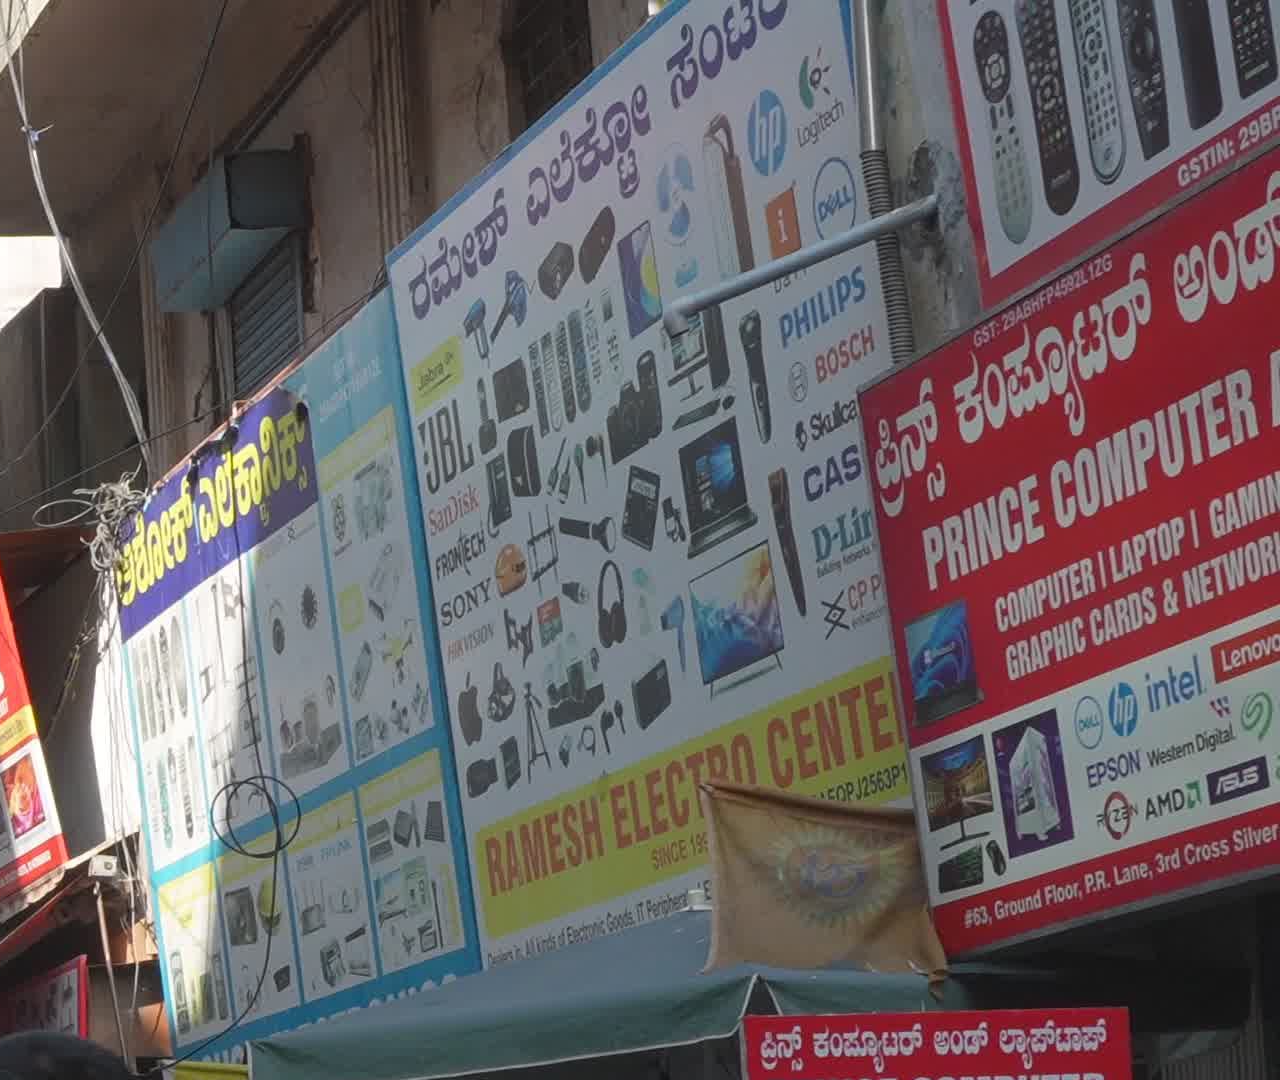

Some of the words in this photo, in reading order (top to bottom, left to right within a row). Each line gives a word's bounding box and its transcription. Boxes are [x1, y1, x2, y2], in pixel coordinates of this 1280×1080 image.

[797, 98, 844, 148] Logitech
[1177, 142, 1234, 187] GSTIN:
[817, 184, 853, 222] DELL
[779, 265, 866, 349] PHILIPS
[815, 325, 875, 384] BOSCH
[972, 321, 1002, 348] GST:
[417, 400, 474, 494] JBL
[921, 472, 1045, 592] PRINCE
[1050, 368, 1260, 528] COMPUTER
[427, 483, 481, 537] SanDisk
[435, 524, 487, 582] FRONTECH
[994, 556, 1095, 632] COMPUTER
[1109, 516, 1186, 583] LAPTOP
[440, 577, 492, 627] SONY
[447, 621, 495, 665] HIKVISION
[1004, 614, 1088, 680] GRAPHIC
[1090, 585, 1159, 647] CARDS
[1162, 578, 1180, 617] &
[1145, 653, 1208, 713] intel
[1087, 750, 1141, 789] EPSON
[1147, 738, 1195, 770] Western
[1215, 765, 1261, 796] ASUS
[483, 803, 606, 899] RAMESH
[605, 732, 757, 850] ELECTRO
[1144, 788, 1186, 821] AMD
[650, 838, 688, 871] SINCE
[994, 893, 1042, 921] Ground
[1044, 879, 1084, 907] Floor,
[1083, 871, 1112, 894] P.R.
[1114, 862, 1154, 887] Lane,
[1155, 851, 1182, 873] 3rd
[1184, 842, 1230, 866] Cross
[1233, 824, 1280, 856] Silver
[566, 917, 605, 946] Electronic
